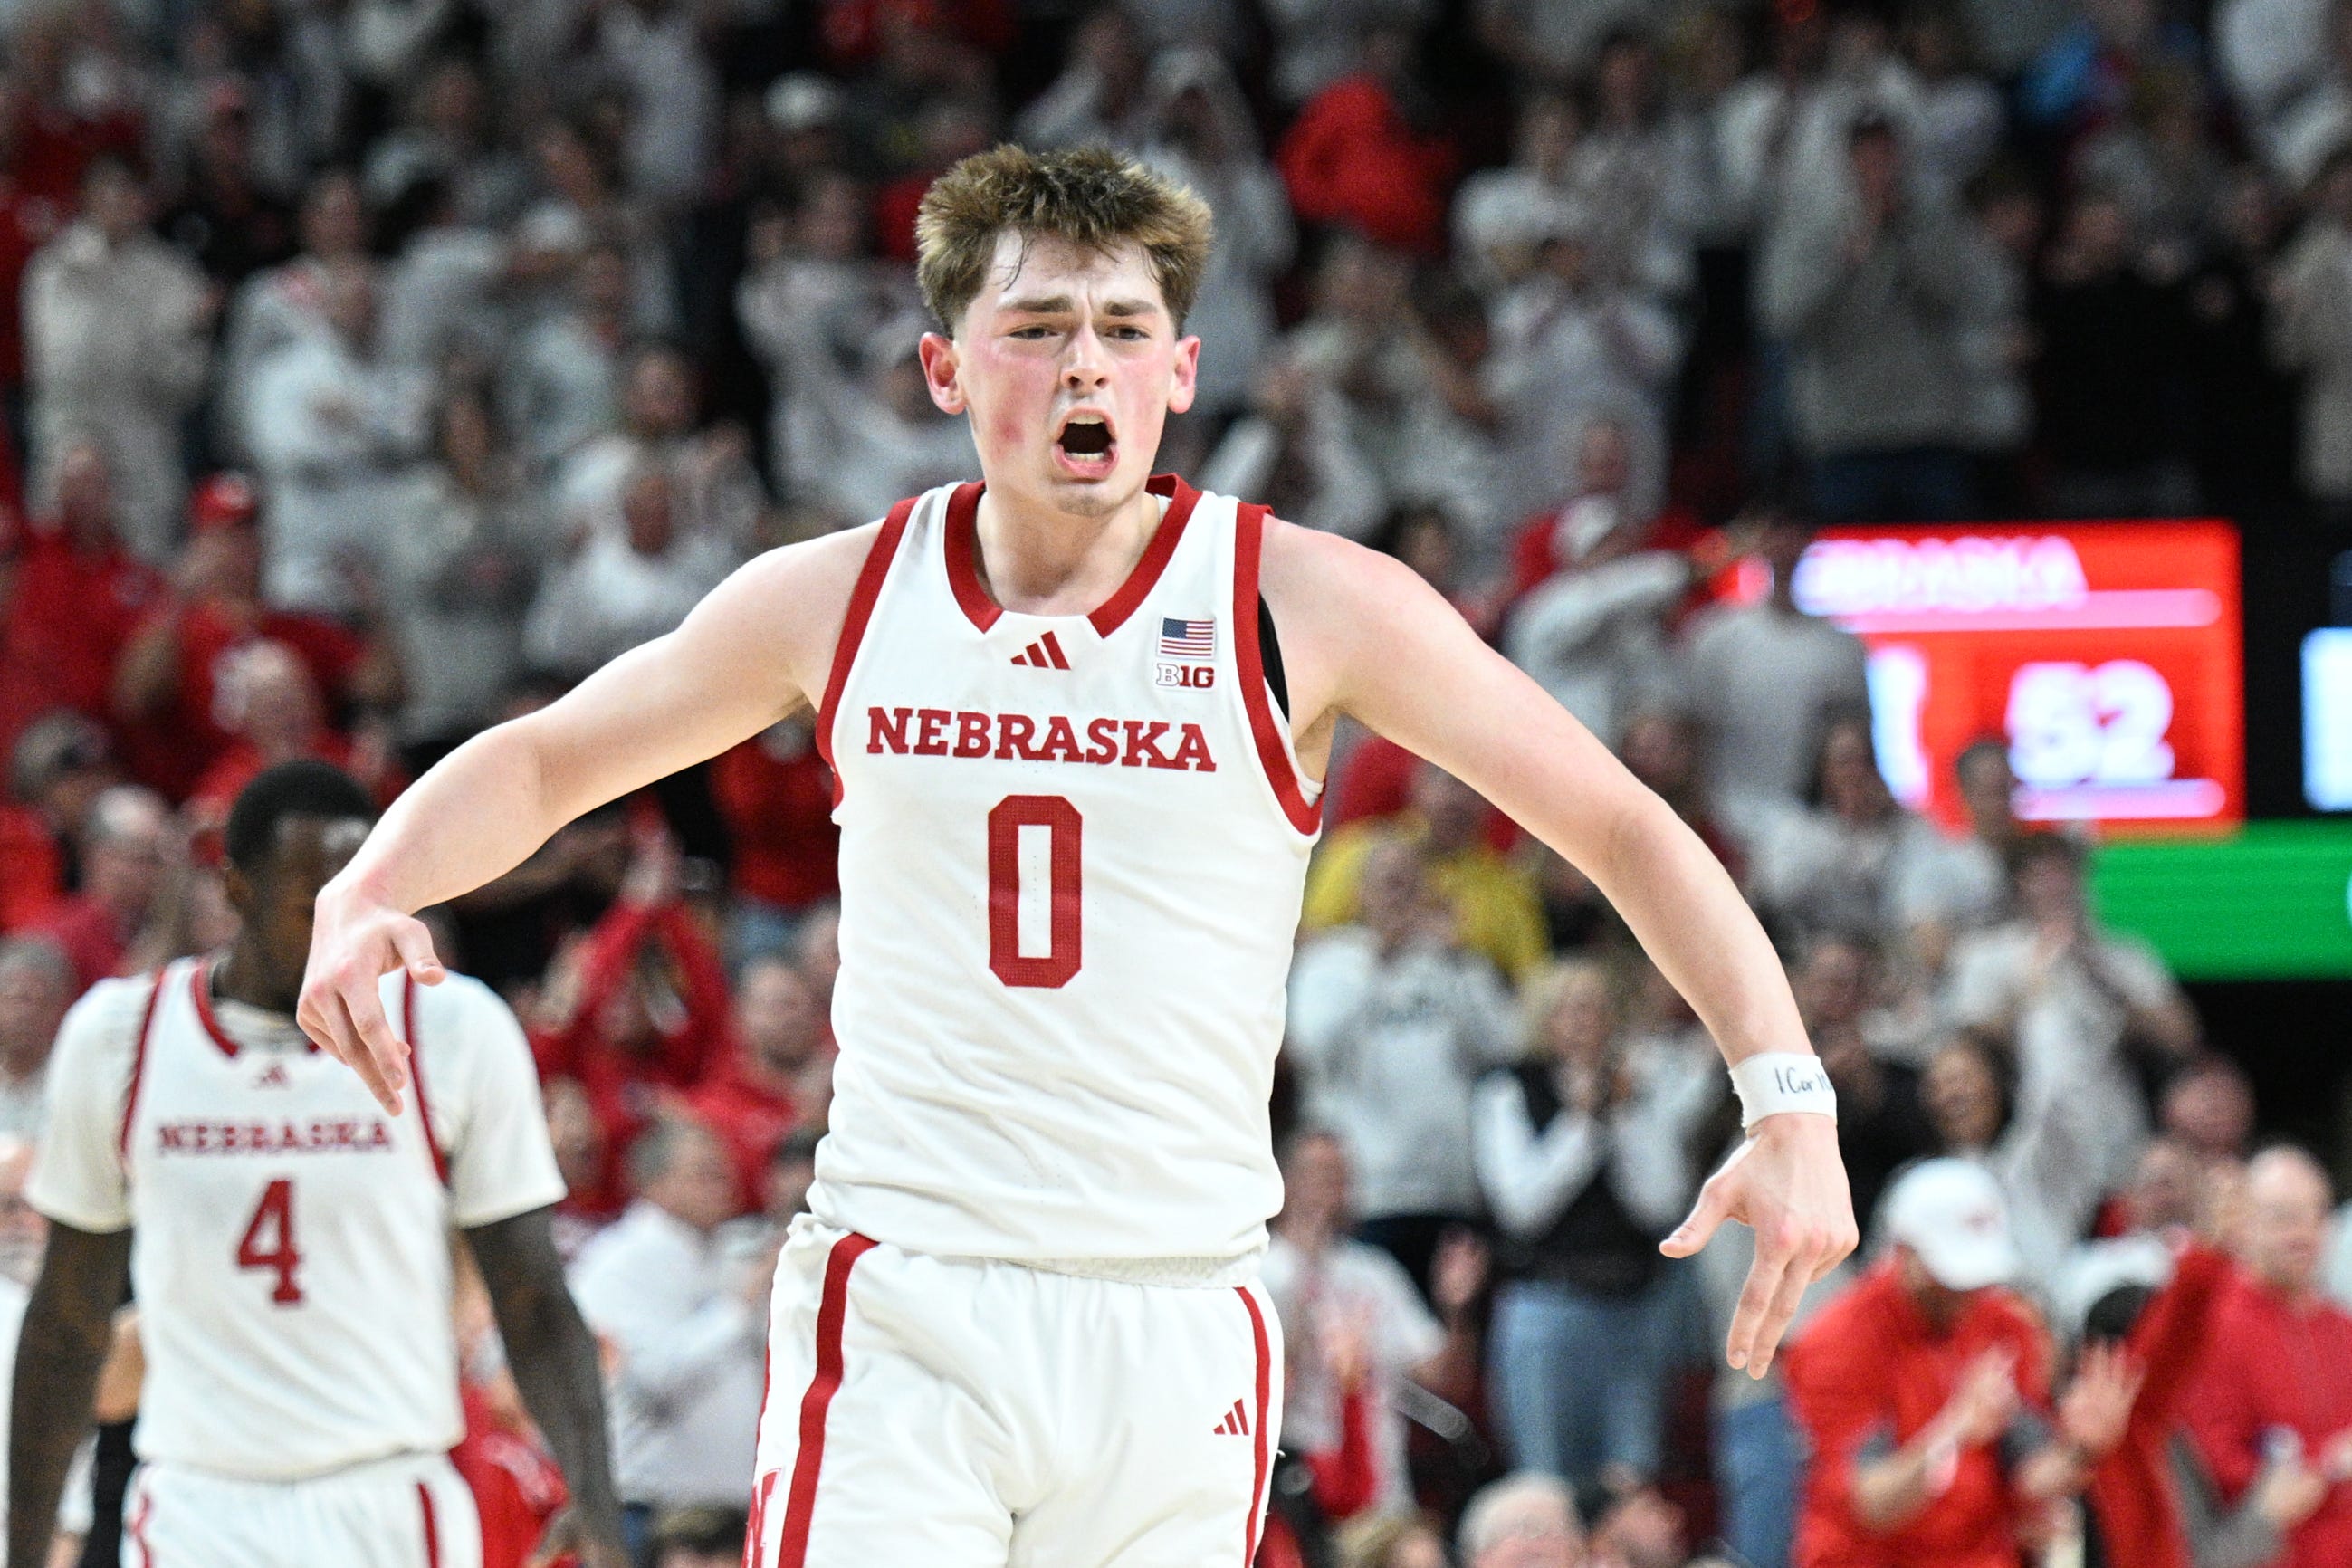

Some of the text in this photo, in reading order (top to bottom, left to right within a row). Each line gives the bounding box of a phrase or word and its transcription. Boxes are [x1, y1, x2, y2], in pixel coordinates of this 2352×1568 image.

[866, 706, 1217, 772] NEBRASKA
[2007, 661, 2174, 787] 52
[988, 795, 1082, 989] 0
[157, 1120, 395, 1154] NEBRASKA
[236, 1178, 304, 1305] 4
